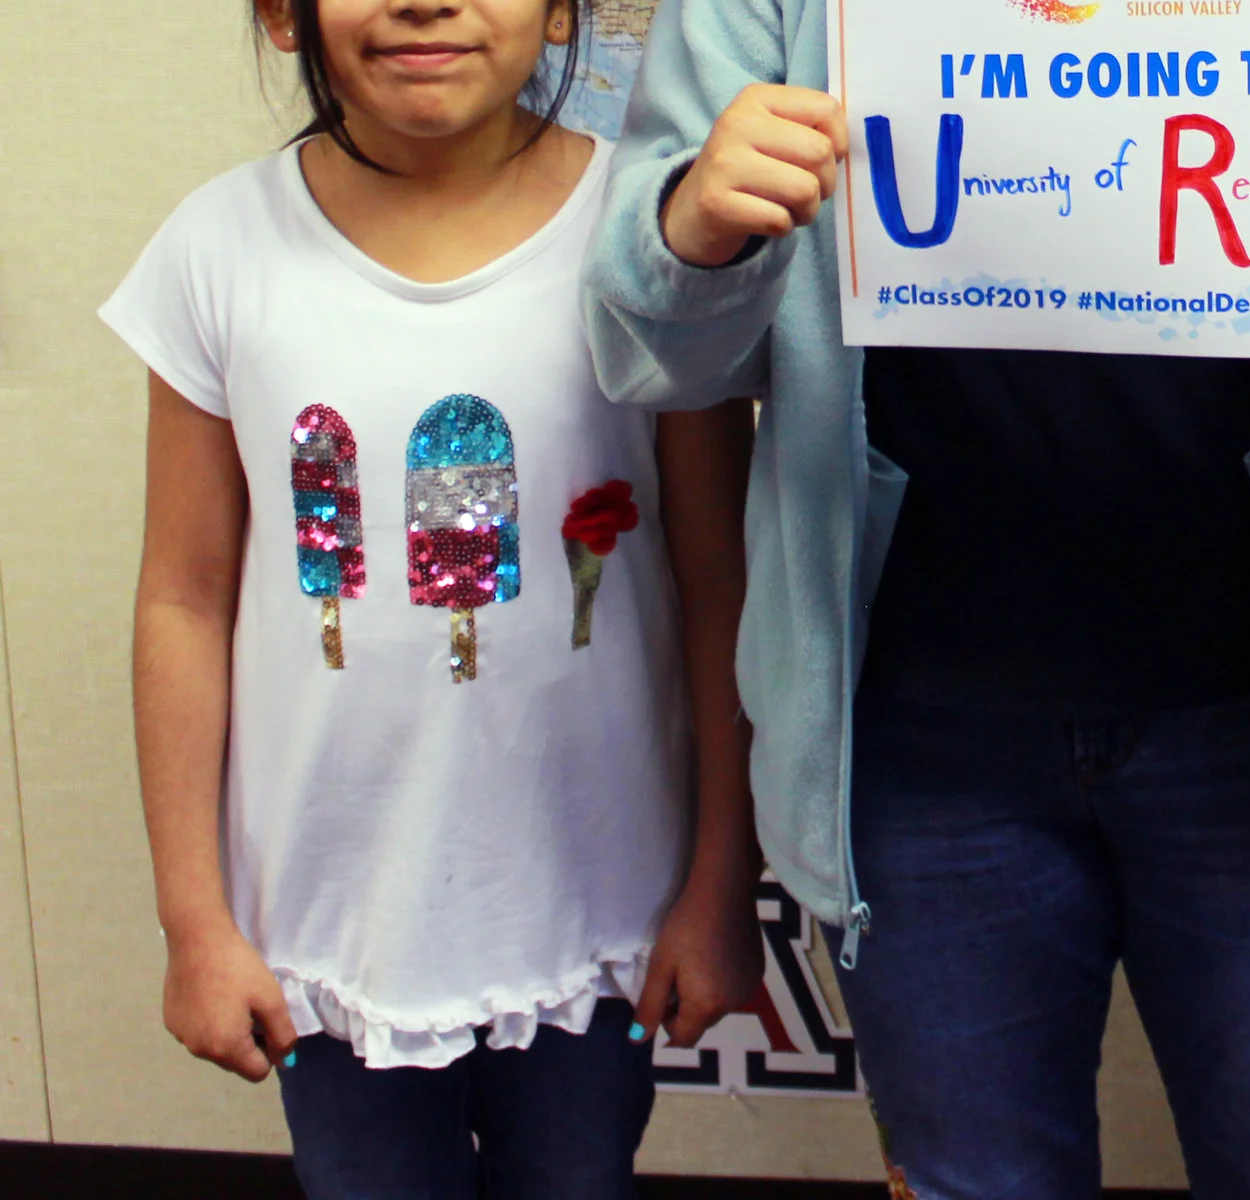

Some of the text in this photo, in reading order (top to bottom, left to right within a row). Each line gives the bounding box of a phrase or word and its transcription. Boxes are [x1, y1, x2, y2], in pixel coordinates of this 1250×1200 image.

[1126, 0, 1243, 16] SILICON VALLEY
[940, 53, 1029, 98] I’M
[1048, 51, 1219, 98] GOING
[864, 113, 1071, 249] University
[1094, 138, 1138, 191] of
[877, 284, 1067, 310] #ClassOf2019
